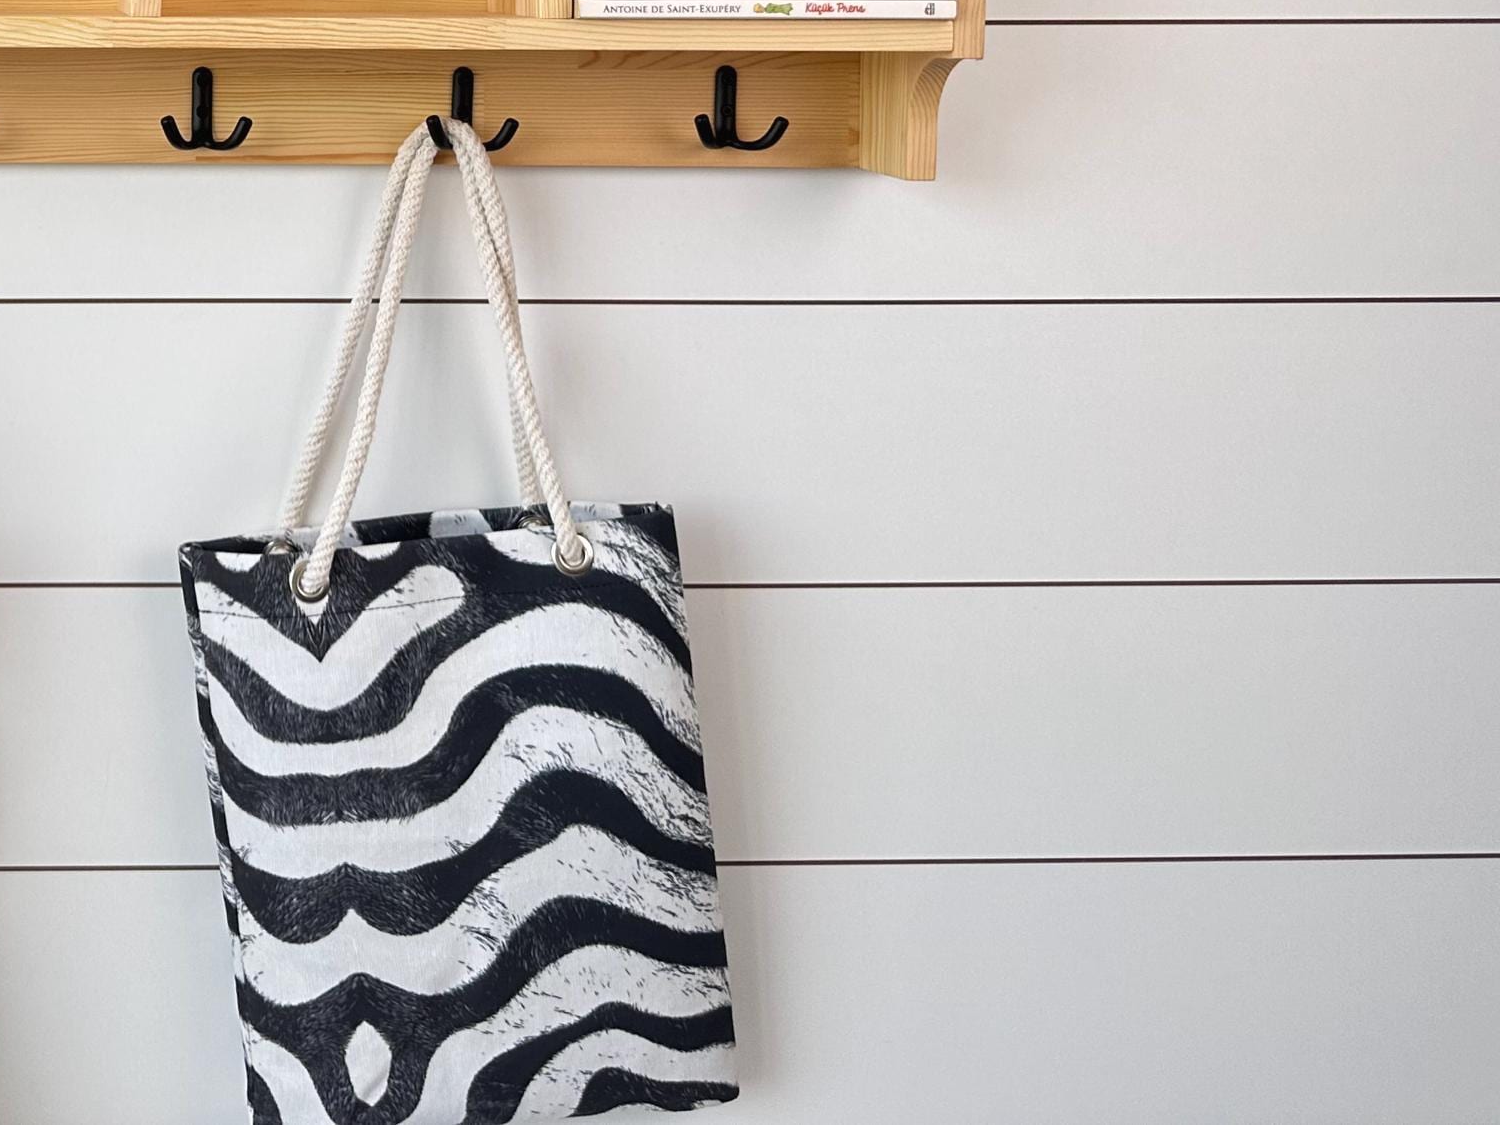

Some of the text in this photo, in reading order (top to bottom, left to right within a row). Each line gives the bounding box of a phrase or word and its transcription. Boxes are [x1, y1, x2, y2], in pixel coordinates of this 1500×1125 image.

[603, 4, 742, 14] ANTOINE DE SAINT-EXUPÉRY
[805, 2, 866, 15] Küçük Prens
